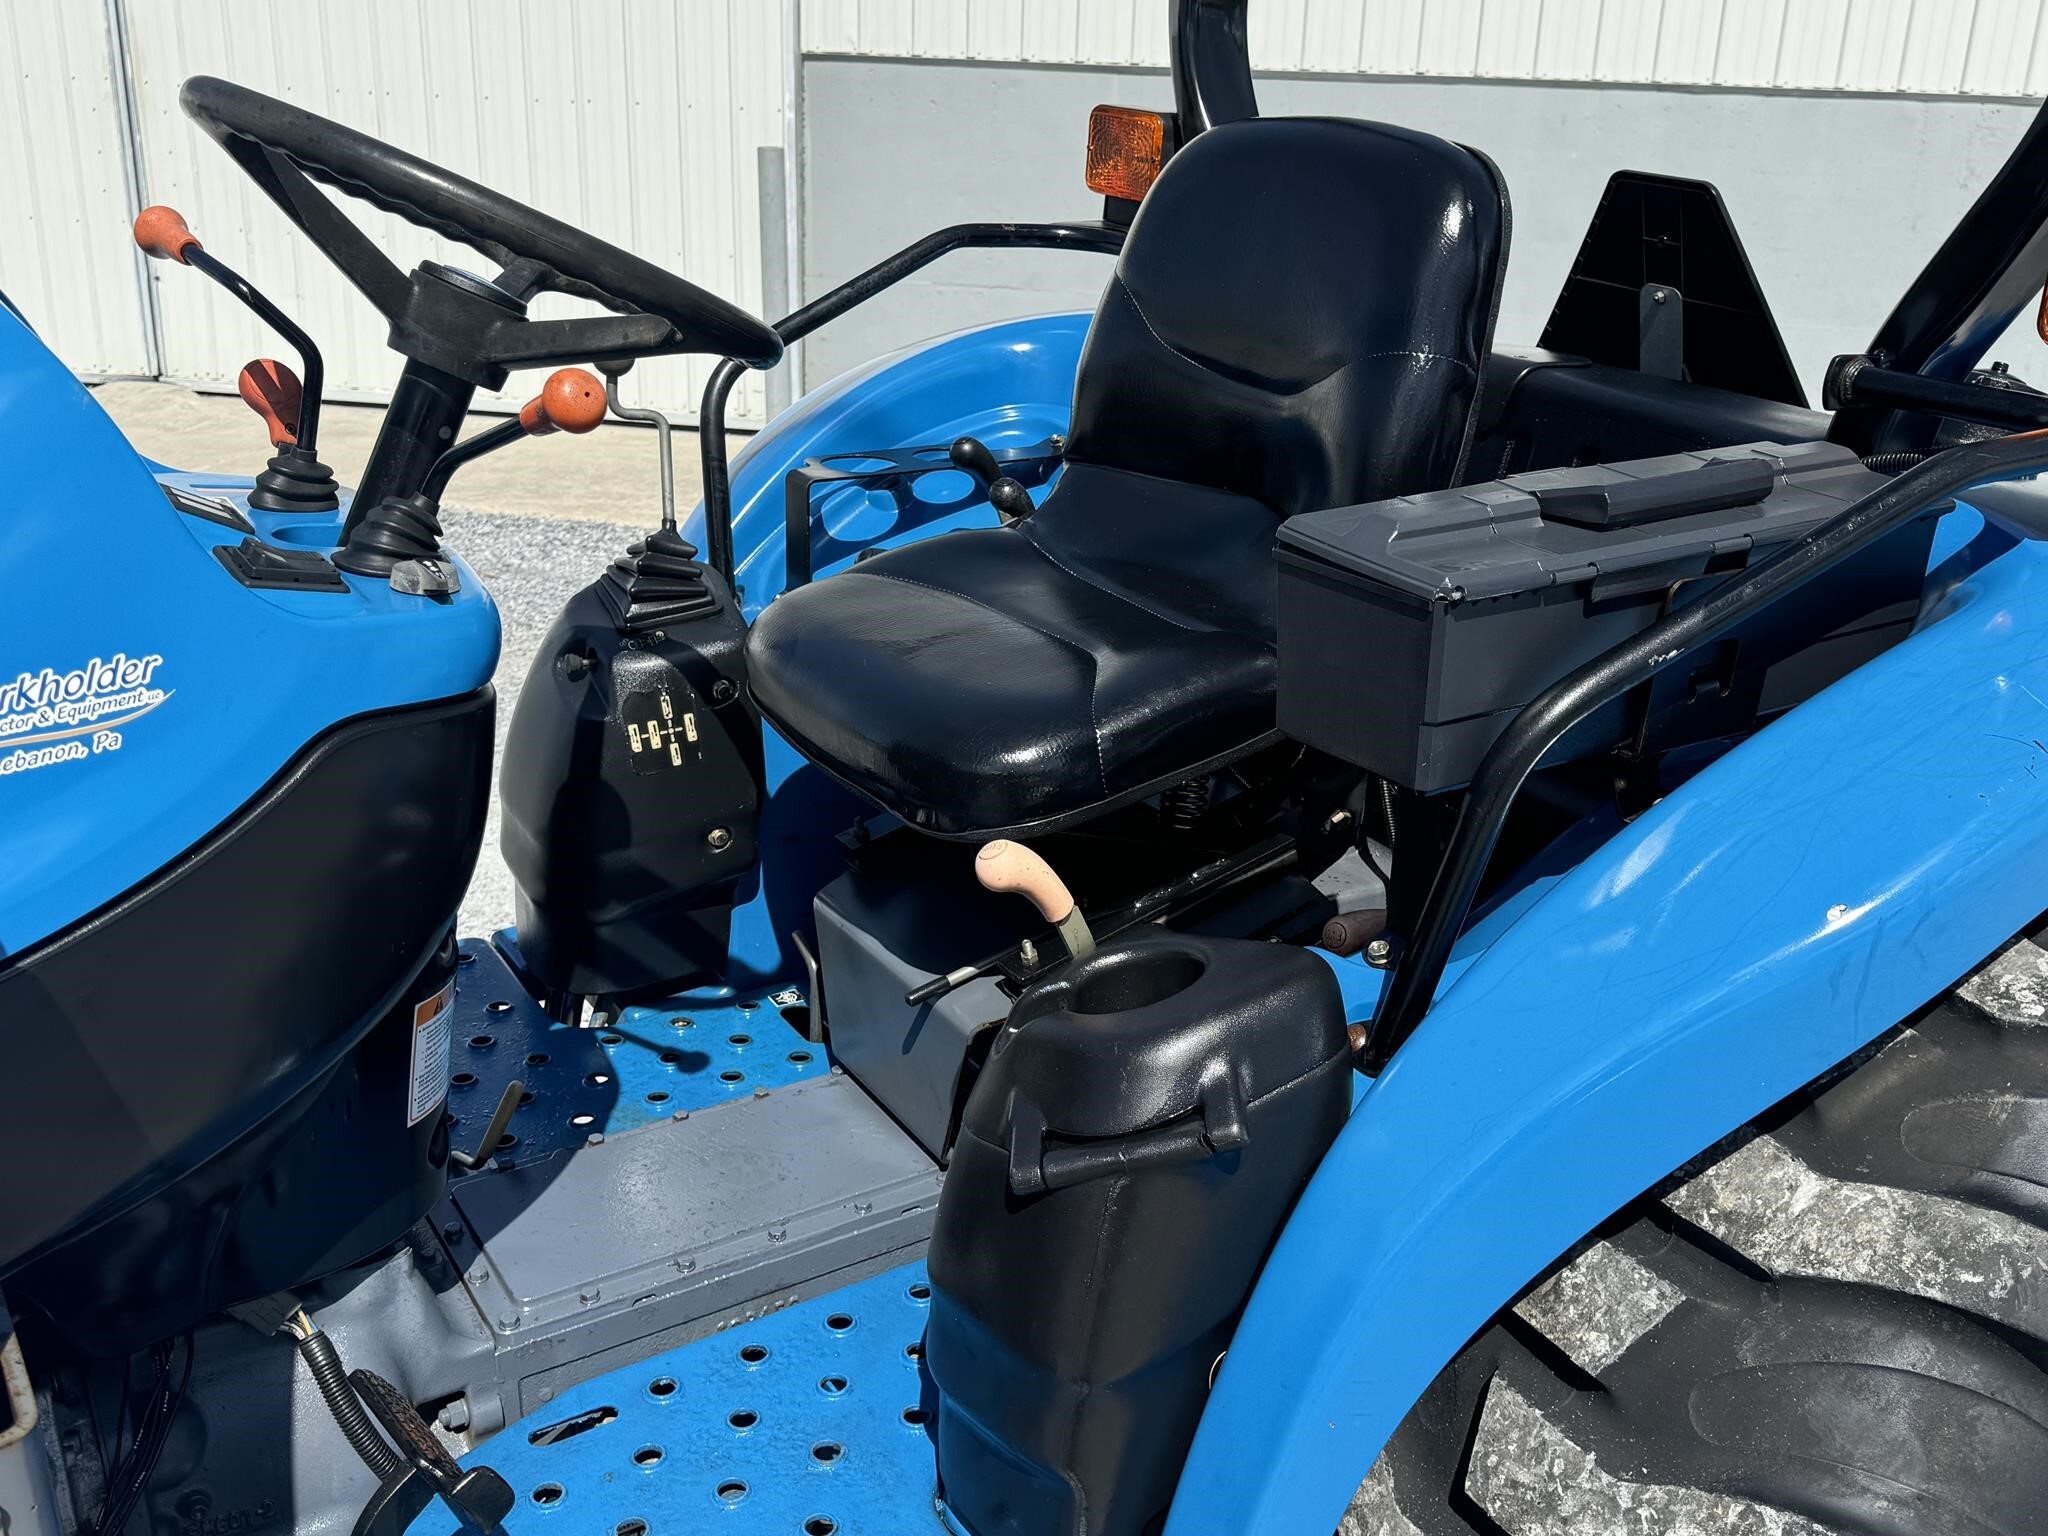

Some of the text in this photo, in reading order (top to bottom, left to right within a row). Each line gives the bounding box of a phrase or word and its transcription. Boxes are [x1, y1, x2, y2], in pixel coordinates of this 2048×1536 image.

[38, 709, 51, 725] &
[57, 690, 144, 721] Equipment
[95, 732, 119, 751] Pa
